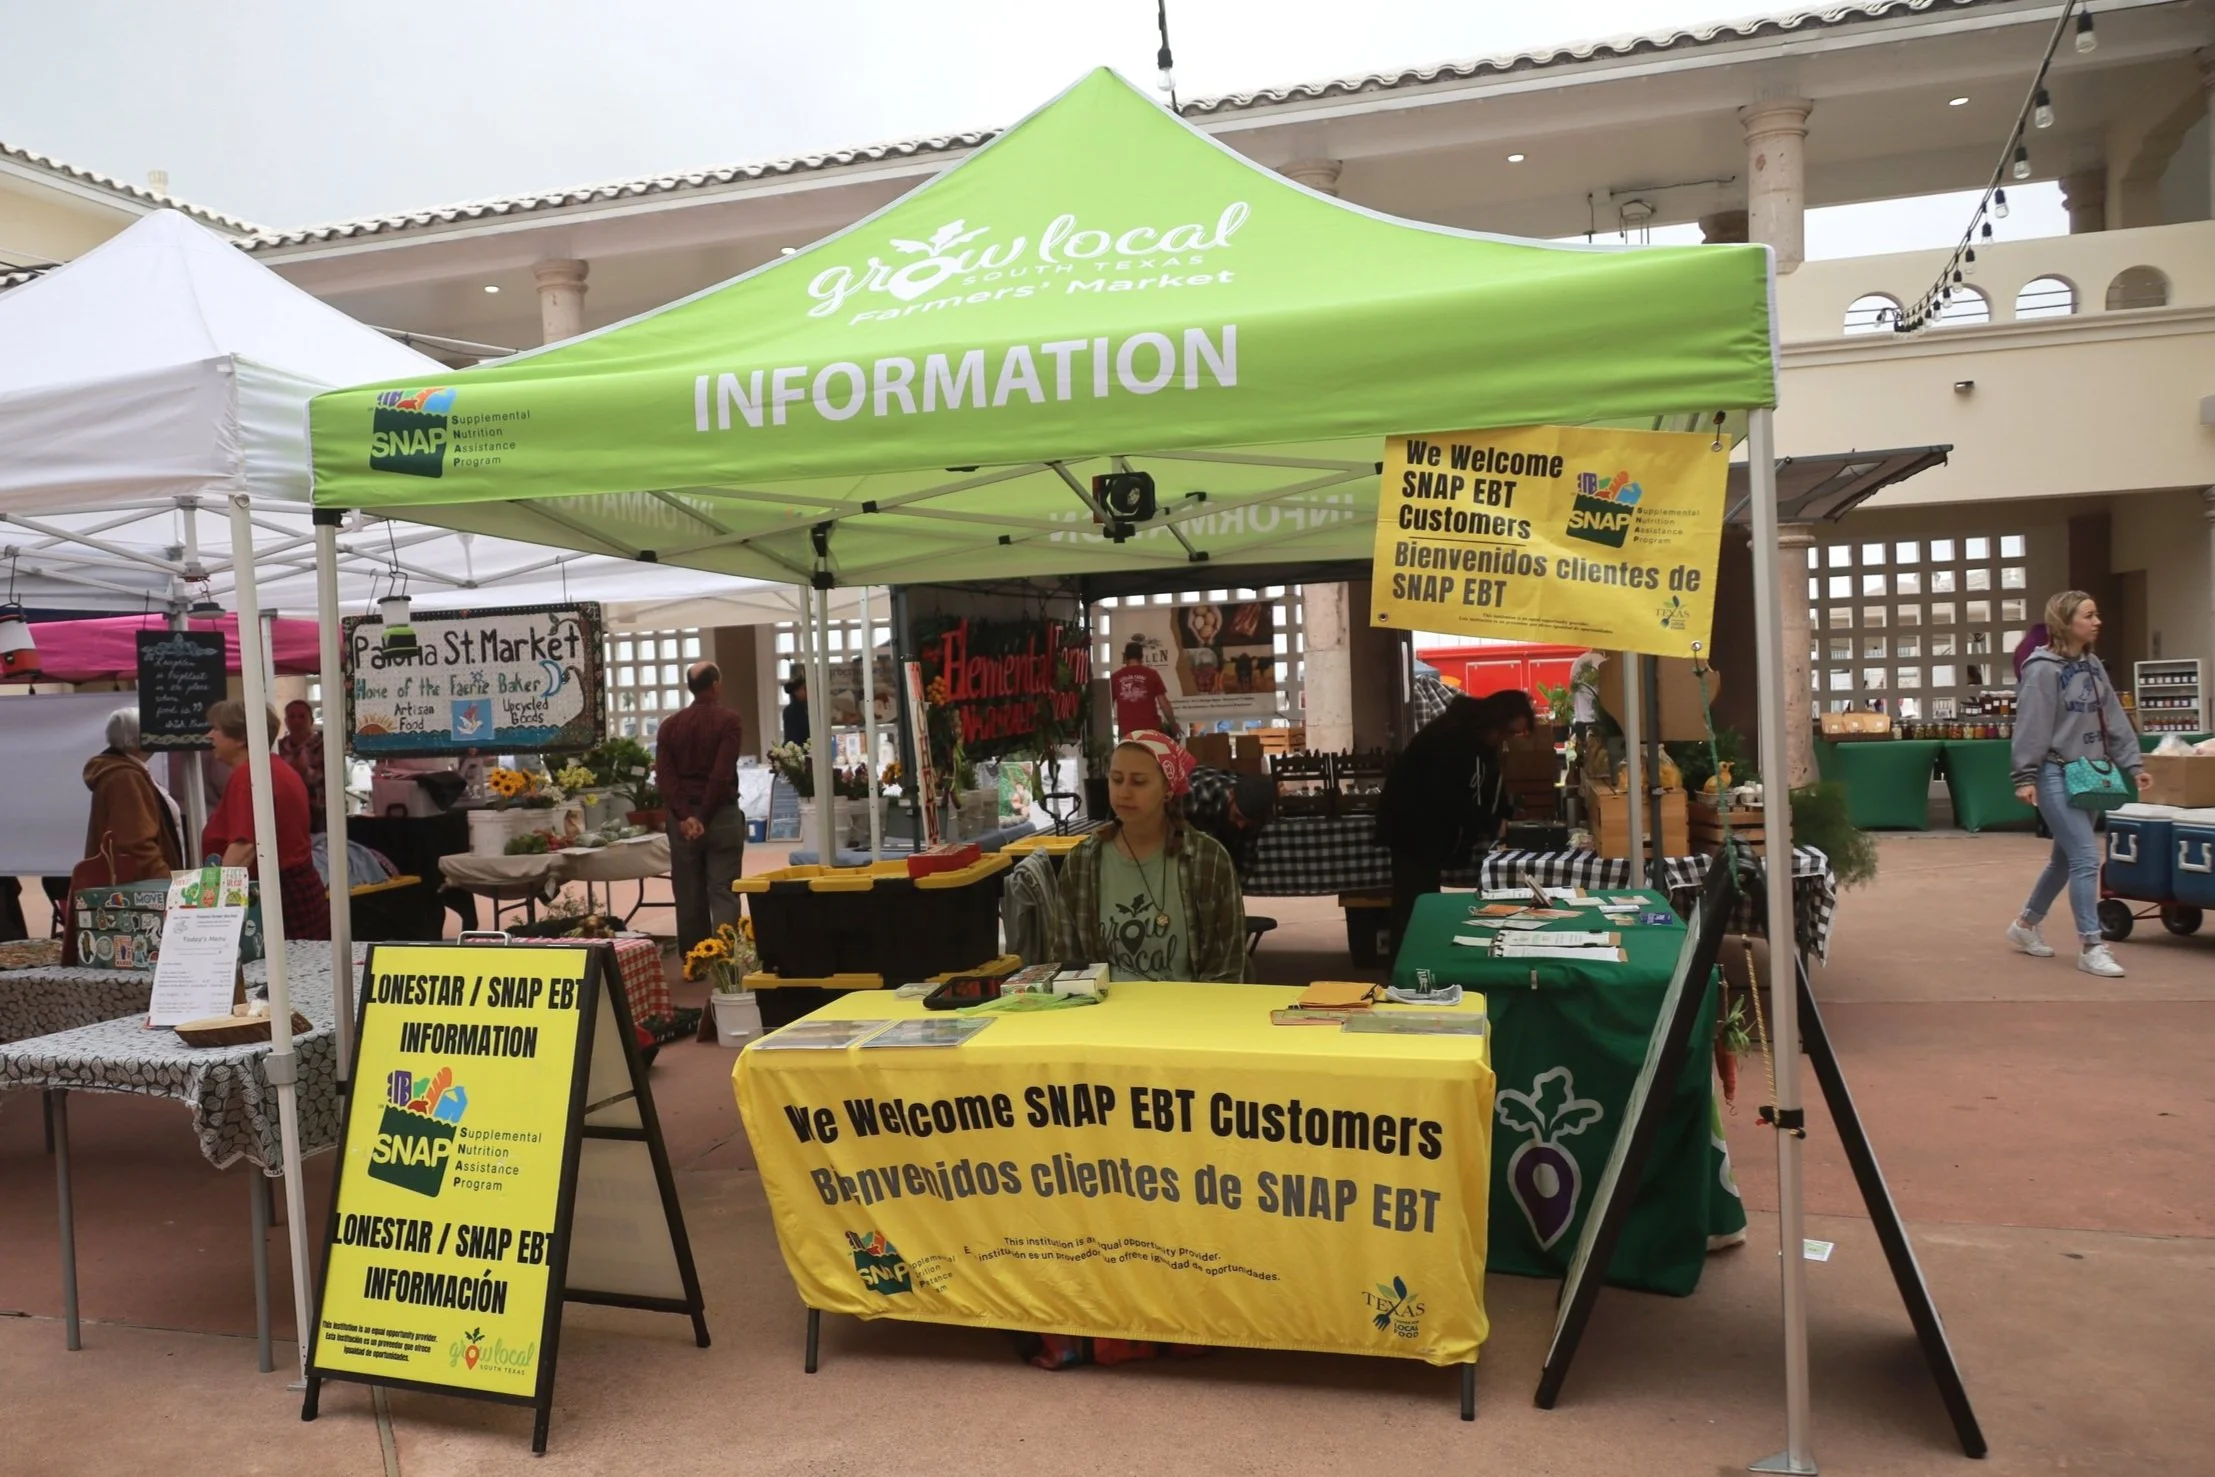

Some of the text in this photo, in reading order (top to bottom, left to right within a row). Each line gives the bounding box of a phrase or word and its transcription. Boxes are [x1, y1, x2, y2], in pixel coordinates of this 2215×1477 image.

[807, 201, 1251, 318] grow local
[962, 255, 1205, 286] SOUTH TEXAS
[1066, 270, 1236, 295] Market
[694, 324, 1238, 432] INFORMATION
[451, 410, 531, 425] Supplemental
[371, 427, 448, 459] SNAP
[453, 428, 503, 440] Nutrition
[454, 442, 516, 454] Assistance
[1406, 440, 1564, 479] We Welcome
[453, 457, 502, 468] Program
[1402, 470, 1517, 509] SNAP EBT
[1399, 504, 1532, 540] Customers
[1568, 510, 1631, 532] SNAP
[1635, 517, 1675, 526] Nutrition
[1637, 507, 1700, 517] Supplemental
[1633, 536, 1672, 545] Program
[1634, 527, 1684, 536] Assistance
[1395, 541, 1701, 592] Bienvenidos clientes de
[1392, 573, 1508, 608] SNAP EBT
[480, 626, 580, 663] Market
[355, 679, 388, 700] Home
[397, 679, 412, 698] of
[419, 677, 441, 697] the
[499, 673, 541, 694] Baker
[394, 697, 549, 717] Artisan Upcycled
[399, 711, 545, 731] Food Goods
[135, 893, 164, 905] MOVE
[366, 974, 584, 1010] LONESTAR / SNAP EBT
[400, 1022, 538, 1058] INFORMATION
[844, 1093, 1016, 1138] Welcome
[1024, 1083, 1116, 1129] SNAP
[1130, 1086, 1195, 1133] EBT
[1210, 1092, 1444, 1161] Customers
[460, 1127, 543, 1144] Supplemental
[372, 1133, 453, 1169] SNAP
[457, 1144, 510, 1158] Nutrition
[455, 1160, 520, 1176] Assistance
[453, 1177, 503, 1192] Program
[1031, 1152, 1181, 1202] clientes
[1194, 1163, 1242, 1211] de
[1257, 1170, 1358, 1223] SNAP
[1373, 1183, 1441, 1234] EBT
[333, 1213, 434, 1254] LONESTAR
[437, 1223, 452, 1255] /
[456, 1224, 513, 1262] SNAP
[1004, 1237, 1024, 1247] This
[1076, 1238, 1085, 1248] is
[1028, 1251, 1040, 1260] es
[1041, 1251, 1054, 1260] un
[364, 1266, 508, 1315] INFORMACIÓN
[1361, 1291, 1426, 1317] TEXAS
[495, 1337, 536, 1366] local
[480, 1364, 526, 1376] SOUTH TEXAS
